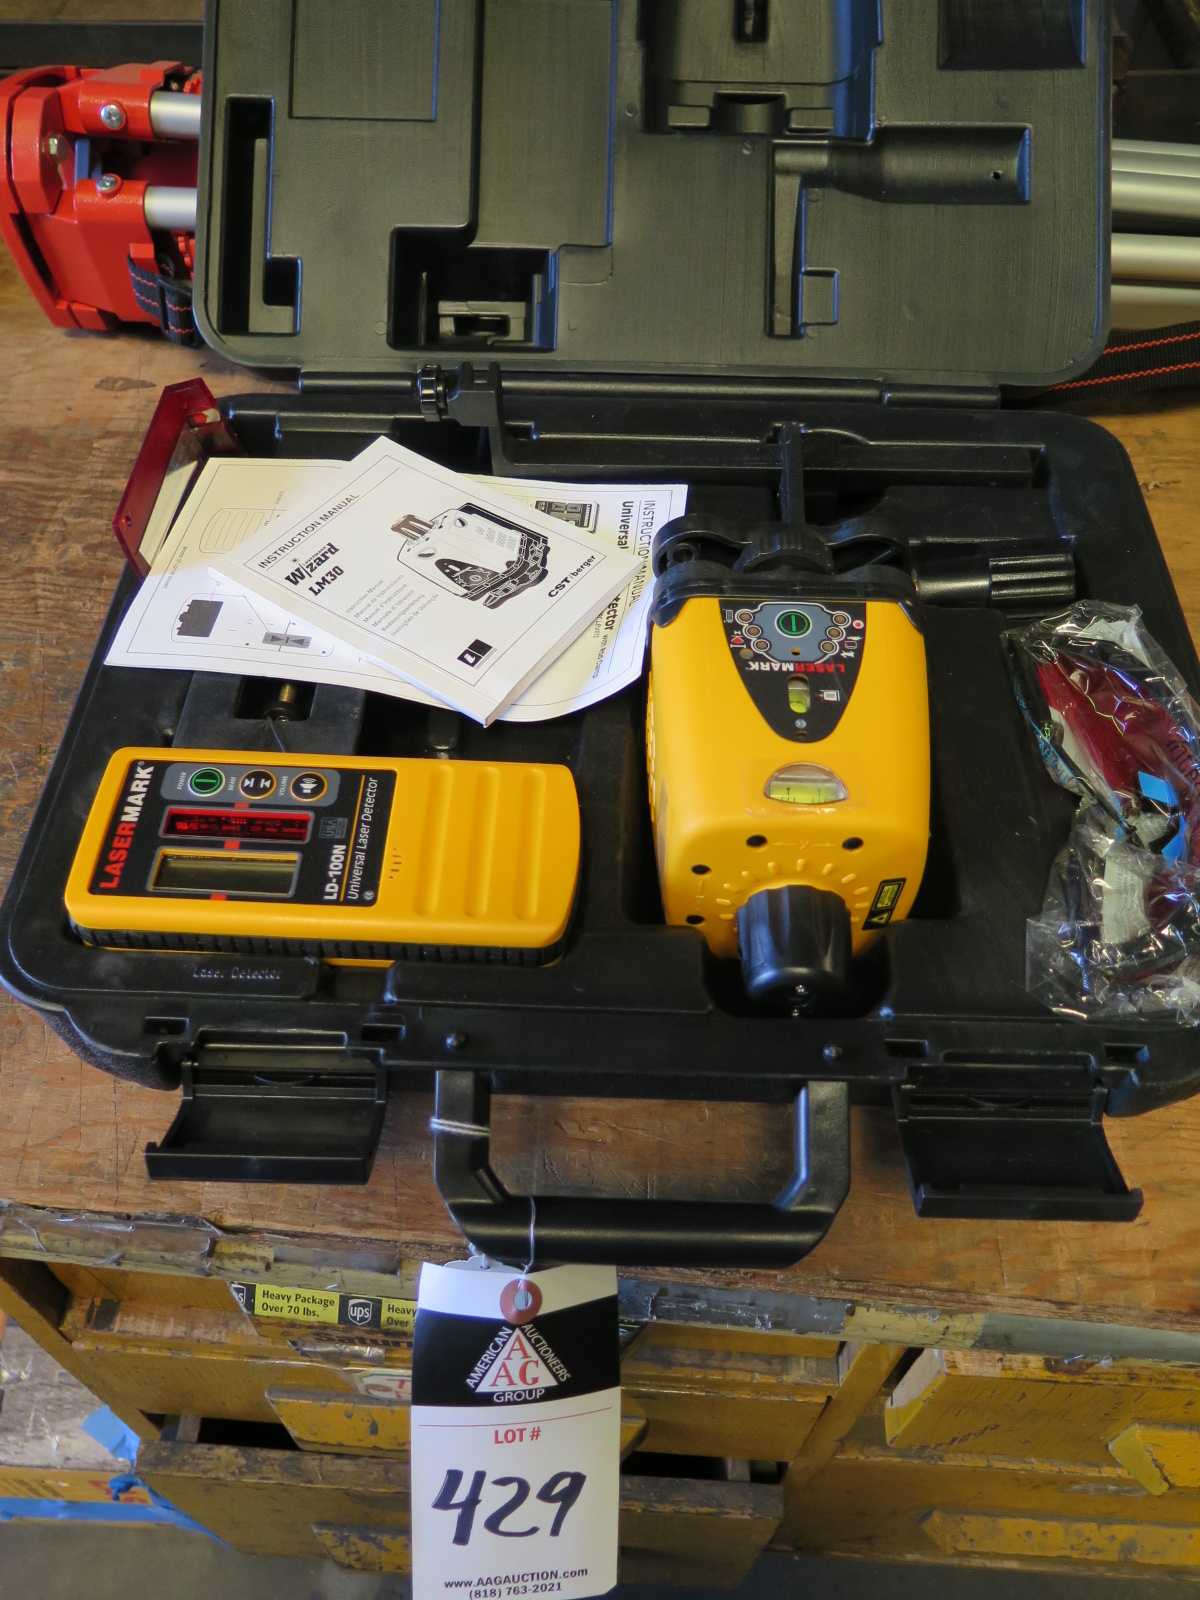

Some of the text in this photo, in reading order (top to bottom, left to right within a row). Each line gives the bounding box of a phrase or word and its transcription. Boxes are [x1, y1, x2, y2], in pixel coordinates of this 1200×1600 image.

[258, 494, 361, 569] INSTRUCTION MANUAL
[617, 501, 634, 549] Universal
[308, 565, 345, 596] LM30
[604, 593, 621, 631] tector
[748, 661, 846, 674] LASERMARK
[177, 771, 187, 789] POWER
[228, 776, 237, 791] BEAM
[278, 775, 288, 796] VOLUME
[99, 765, 154, 889] LASERMARK
[347, 777, 379, 901] Universal Laser Detector
[323, 844, 347, 901] LD-100N
[192, 966, 285, 980] Laser Detector
[262, 1290, 335, 1308] Heavy Package
[261, 1302, 320, 1318] Over 70 lbs.
[350, 1306, 370, 1321] ups
[386, 1317, 409, 1327] Over
[465, 1326, 514, 1388] AMERICAN
[504, 1334, 532, 1360] A
[521, 1323, 571, 1382] AUCTIONEERS
[489, 1360, 540, 1387] AG
[493, 1388, 545, 1403] GROUP
[494, 1426, 541, 1444] LOT #
[431, 1468, 587, 1546] 429
[444, 1568, 588, 1589] www.AAGAUCTION.com
[469, 1582, 562, 1600] (818) 763-2021
